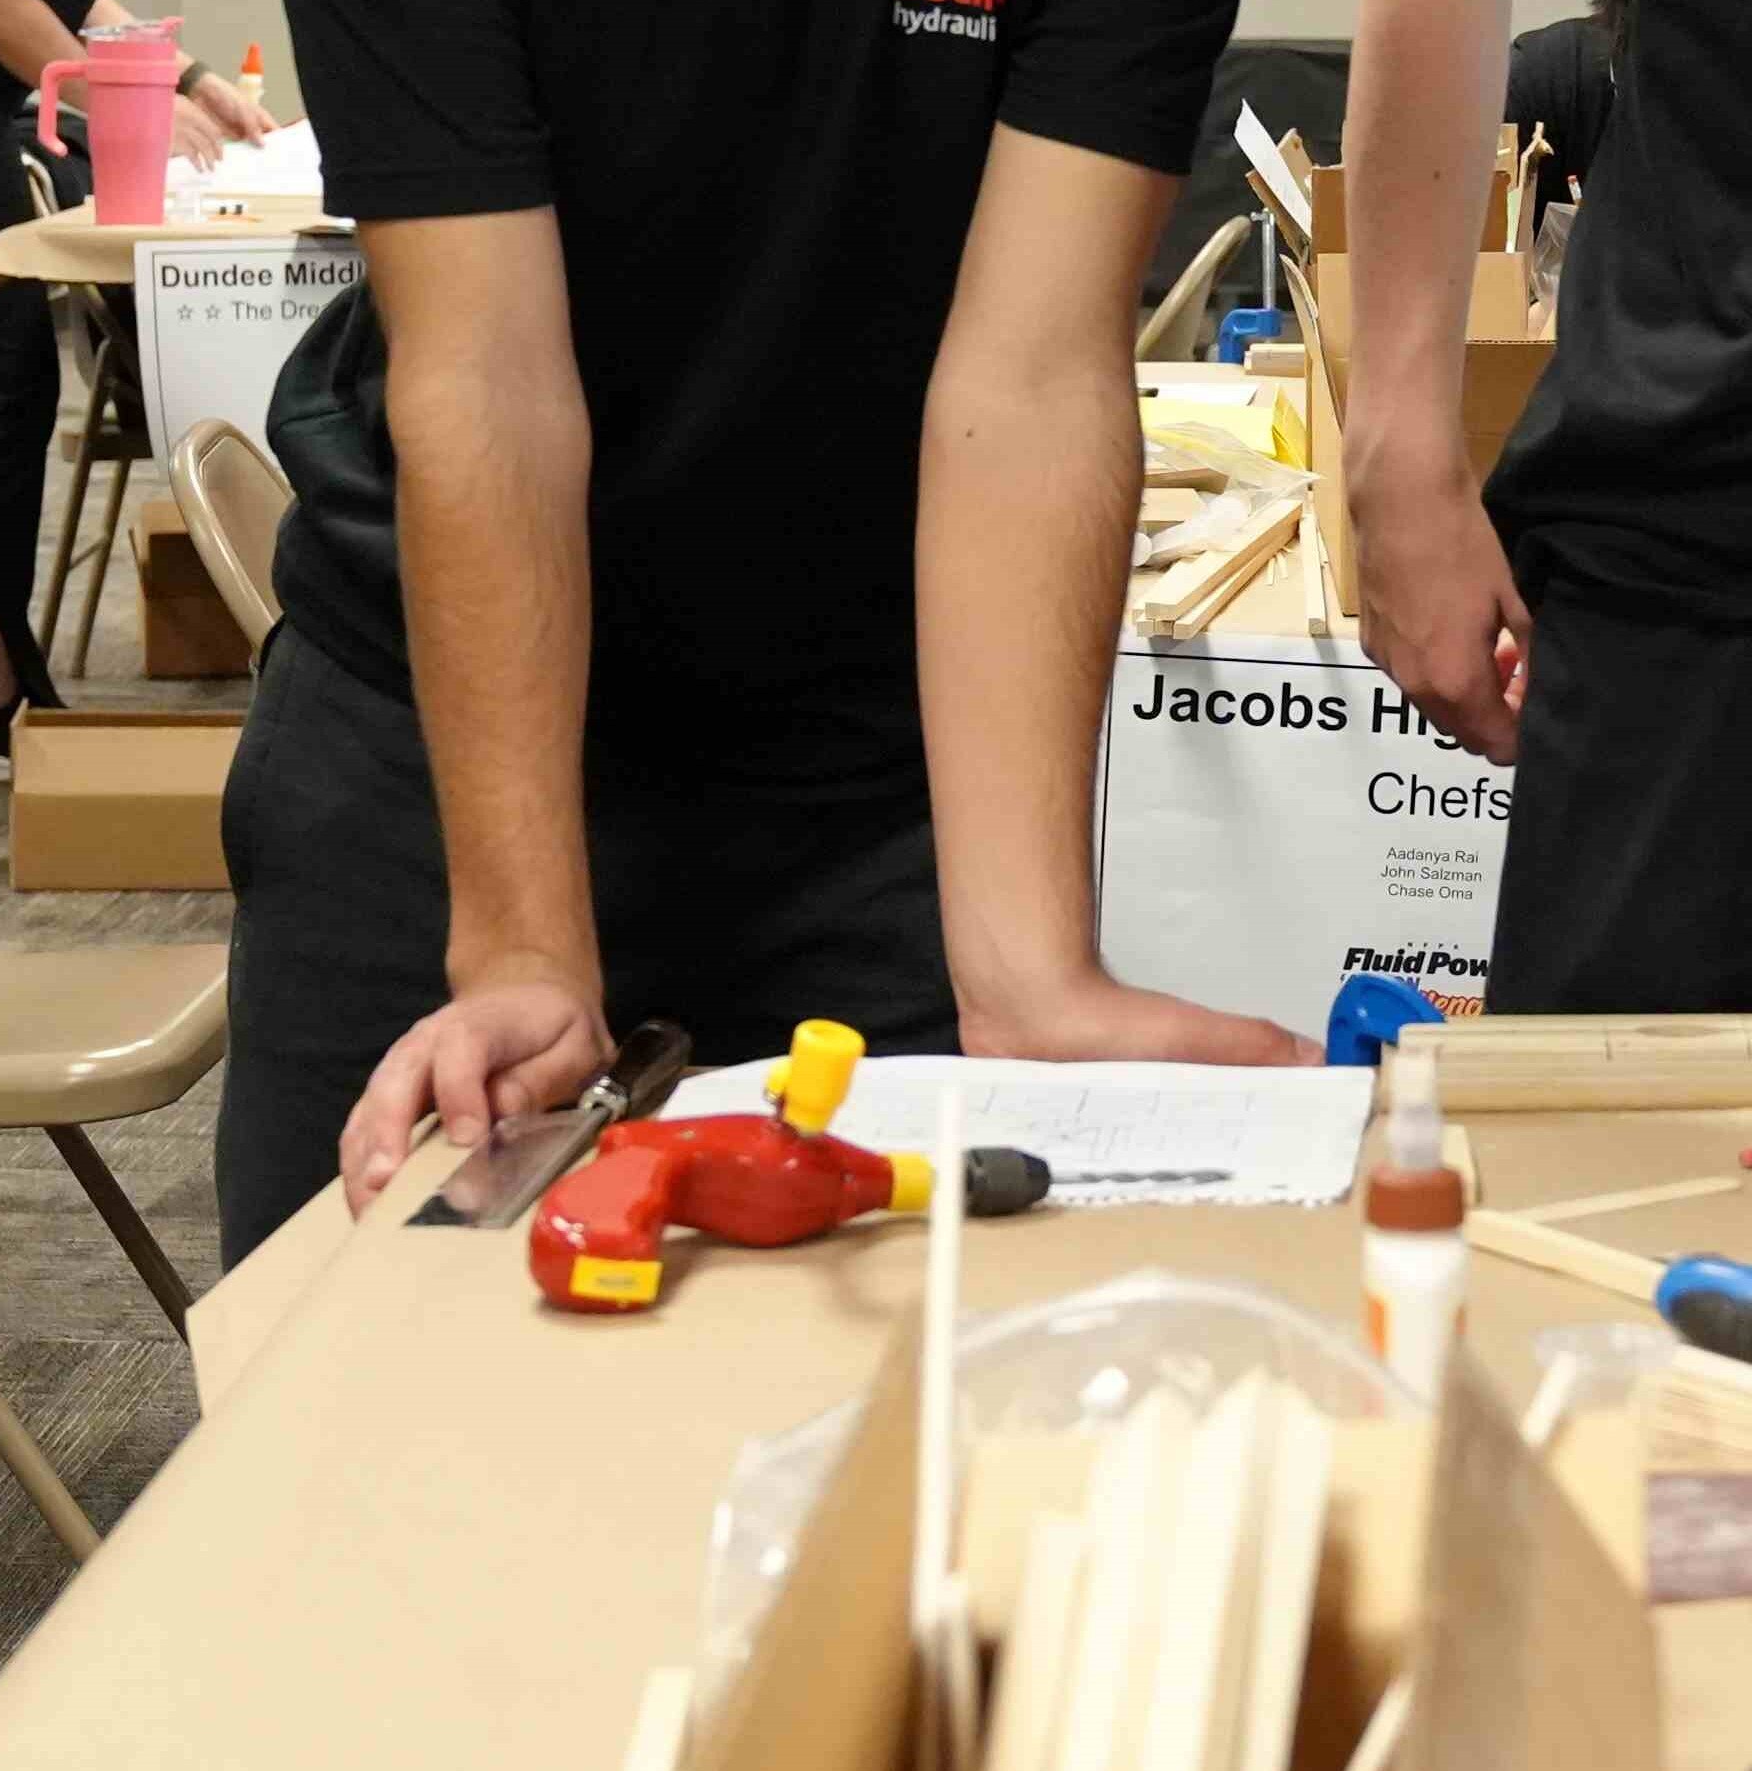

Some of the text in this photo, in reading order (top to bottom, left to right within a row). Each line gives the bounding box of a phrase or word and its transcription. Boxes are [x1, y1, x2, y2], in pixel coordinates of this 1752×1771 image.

[893, 0, 997, 42] hydrauli
[161, 260, 365, 287] Dundee Middl
[232, 299, 321, 320] The Dre
[1133, 674, 1347, 731] Jacobs
[1368, 771, 1512, 821] Chefs
[1386, 847, 1479, 864] Aadanya Rai
[1381, 866, 1482, 882] John Salzman
[1387, 883, 1473, 900] Chase Oma
[1343, 947, 1489, 977] Fluid Pow
